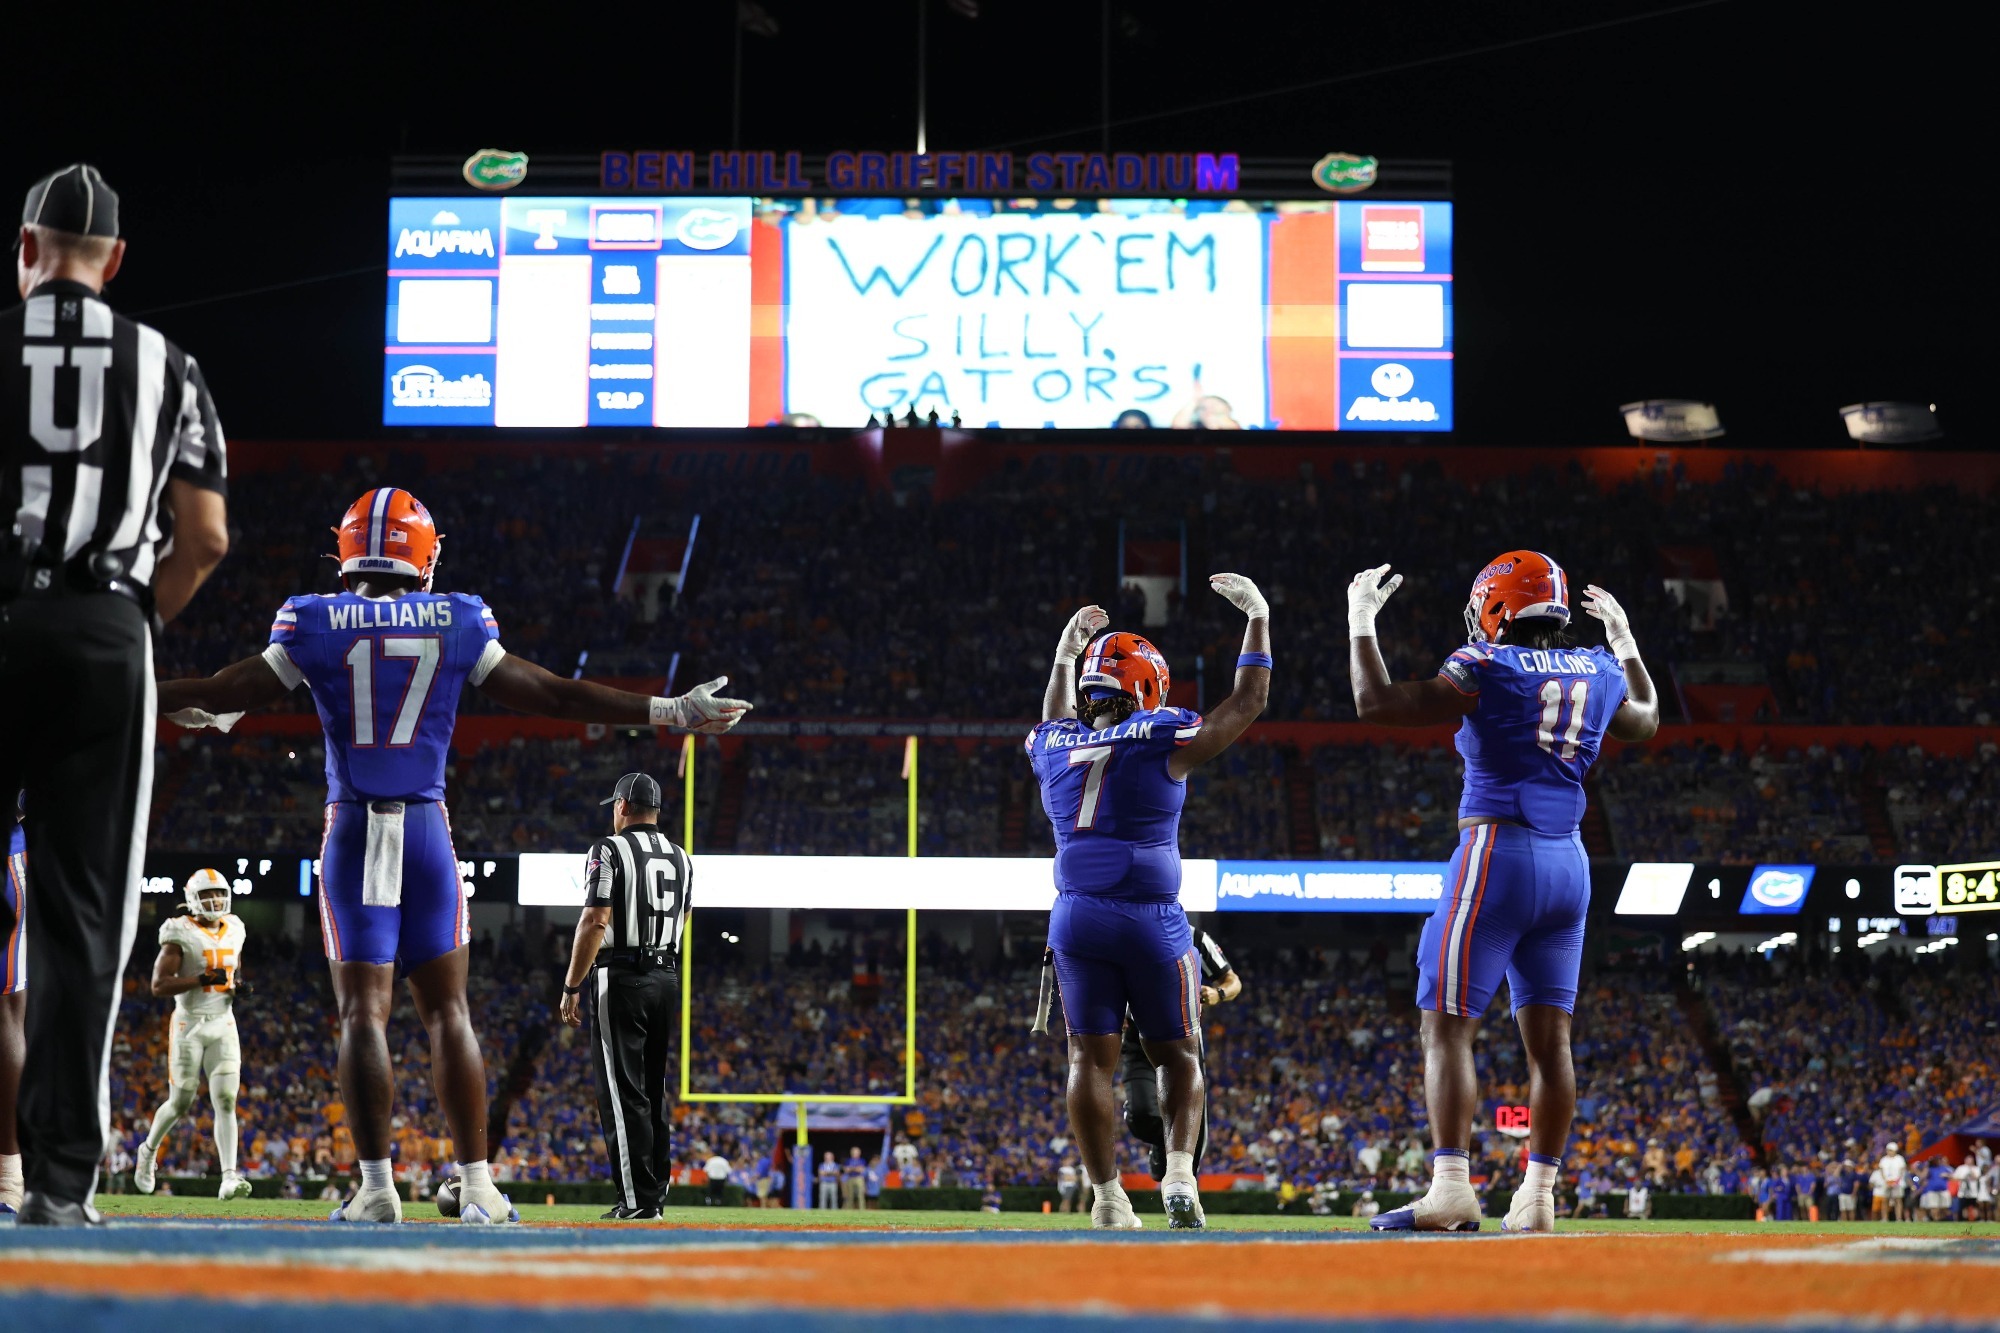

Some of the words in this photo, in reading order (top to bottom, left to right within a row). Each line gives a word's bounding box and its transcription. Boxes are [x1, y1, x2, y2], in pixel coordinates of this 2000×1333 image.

[602, 152, 694, 189] BEN
[709, 152, 811, 189] HILL
[827, 152, 1012, 190] GRIFFIN
[1026, 153, 1239, 191] STADIUM
[22, 346, 113, 453] U
[358, 560, 394, 570] FLORIDA
[328, 601, 452, 630] WILLIAMS
[1519, 651, 1598, 675] COLLINS
[343, 634, 443, 748] 17
[1045, 721, 1154, 750] McCLELLAN
[1536, 677, 1591, 762] 11
[1068, 745, 1114, 832] 7
[645, 858, 677, 912] C
[1707, 878, 1721, 899] 1
[1845, 879, 1861, 899] 0
[202, 948, 235, 993] 15
